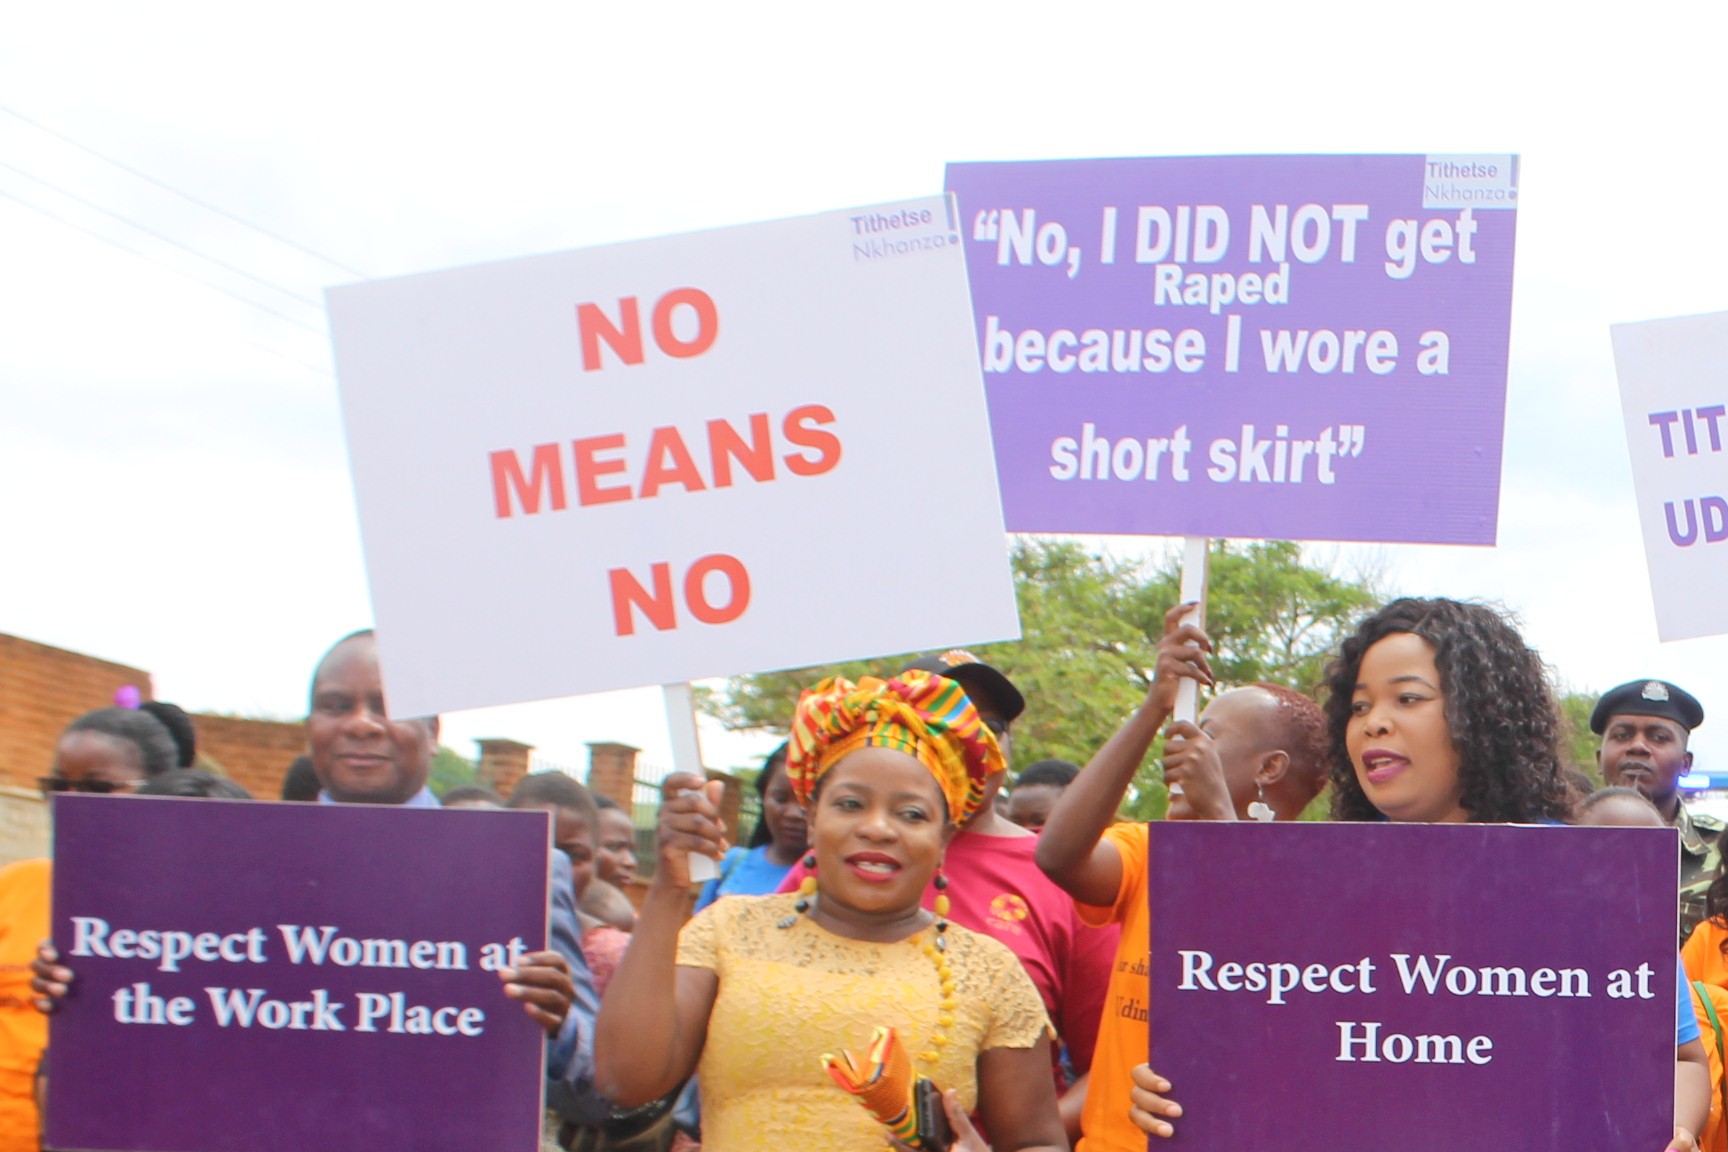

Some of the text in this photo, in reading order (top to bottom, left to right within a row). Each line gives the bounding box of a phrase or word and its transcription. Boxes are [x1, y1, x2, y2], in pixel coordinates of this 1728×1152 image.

[1426, 160, 1498, 179] Tithetse
[850, 207, 932, 236] Tithetse
[972, 204, 1478, 279] “No, I DID NOT get
[1153, 263, 1290, 314] Raped
[574, 286, 720, 372] NO
[983, 315, 1451, 375] because I wore a
[487, 404, 843, 520] MEANS
[1049, 423, 1366, 484] short skirt”
[608, 552, 752, 637] NO
[69, 916, 528, 973] Respect Women at
[1177, 950, 1656, 1005] Respect Women at
[111, 982, 485, 1037] the Work Place
[1335, 1021, 1494, 1065] Home
